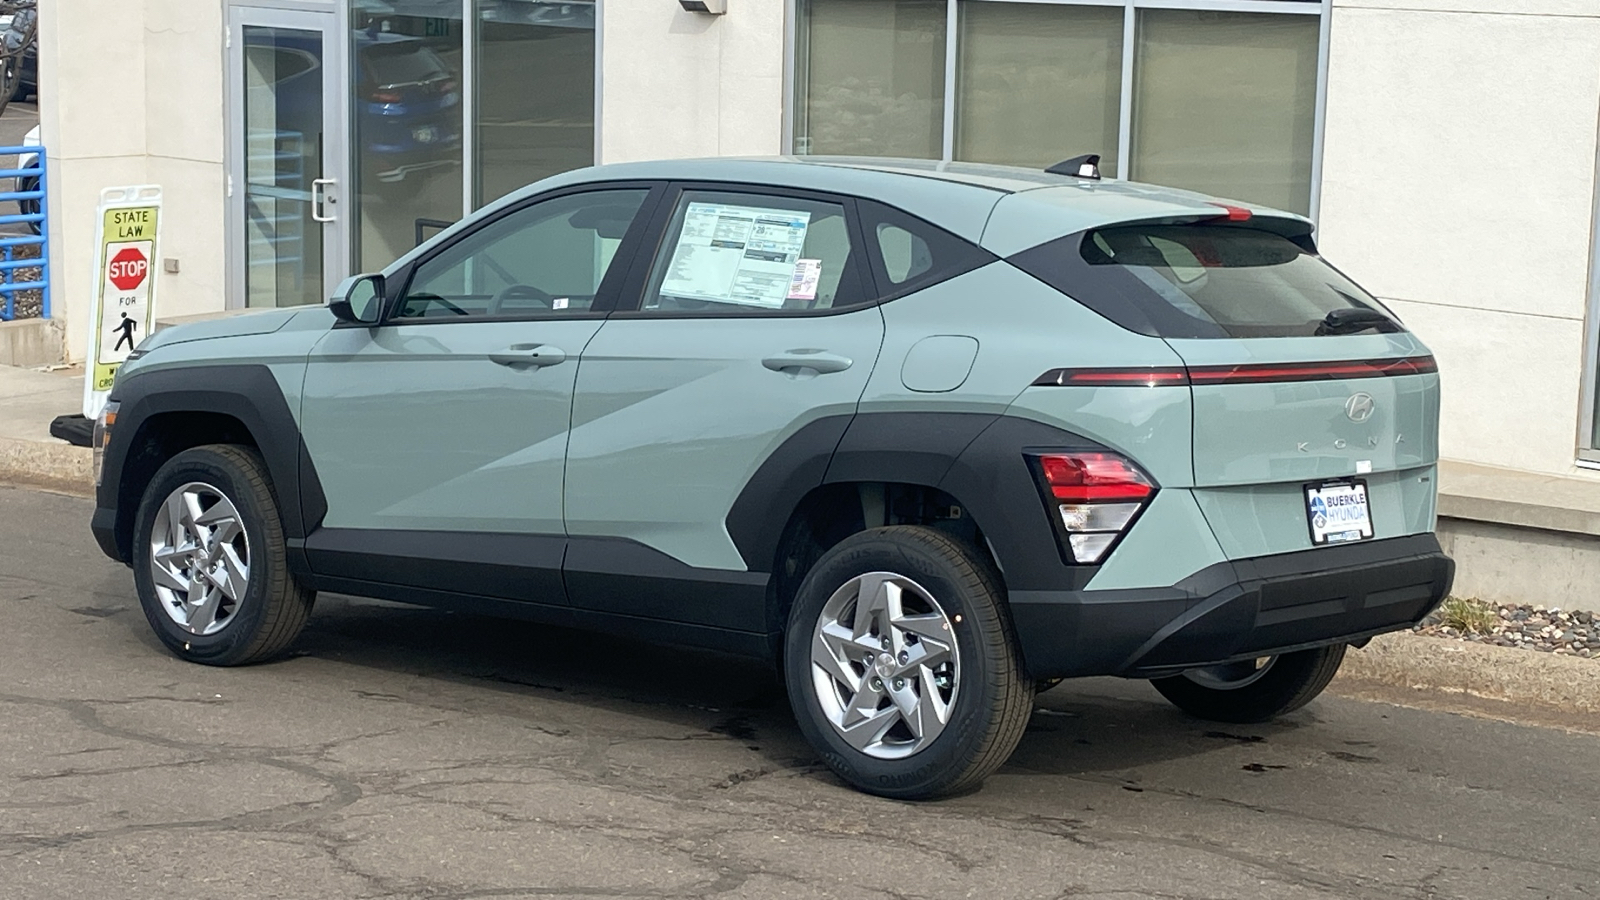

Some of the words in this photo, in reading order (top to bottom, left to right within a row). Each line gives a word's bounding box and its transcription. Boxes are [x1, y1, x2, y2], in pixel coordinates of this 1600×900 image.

[114, 211, 149, 224] STATE
[118, 226, 143, 238] LAW
[110, 260, 147, 278] STOP
[119, 296, 136, 306] FOR
[1297, 433, 1405, 453] KONA
[1326, 493, 1366, 508] BUERKLE
